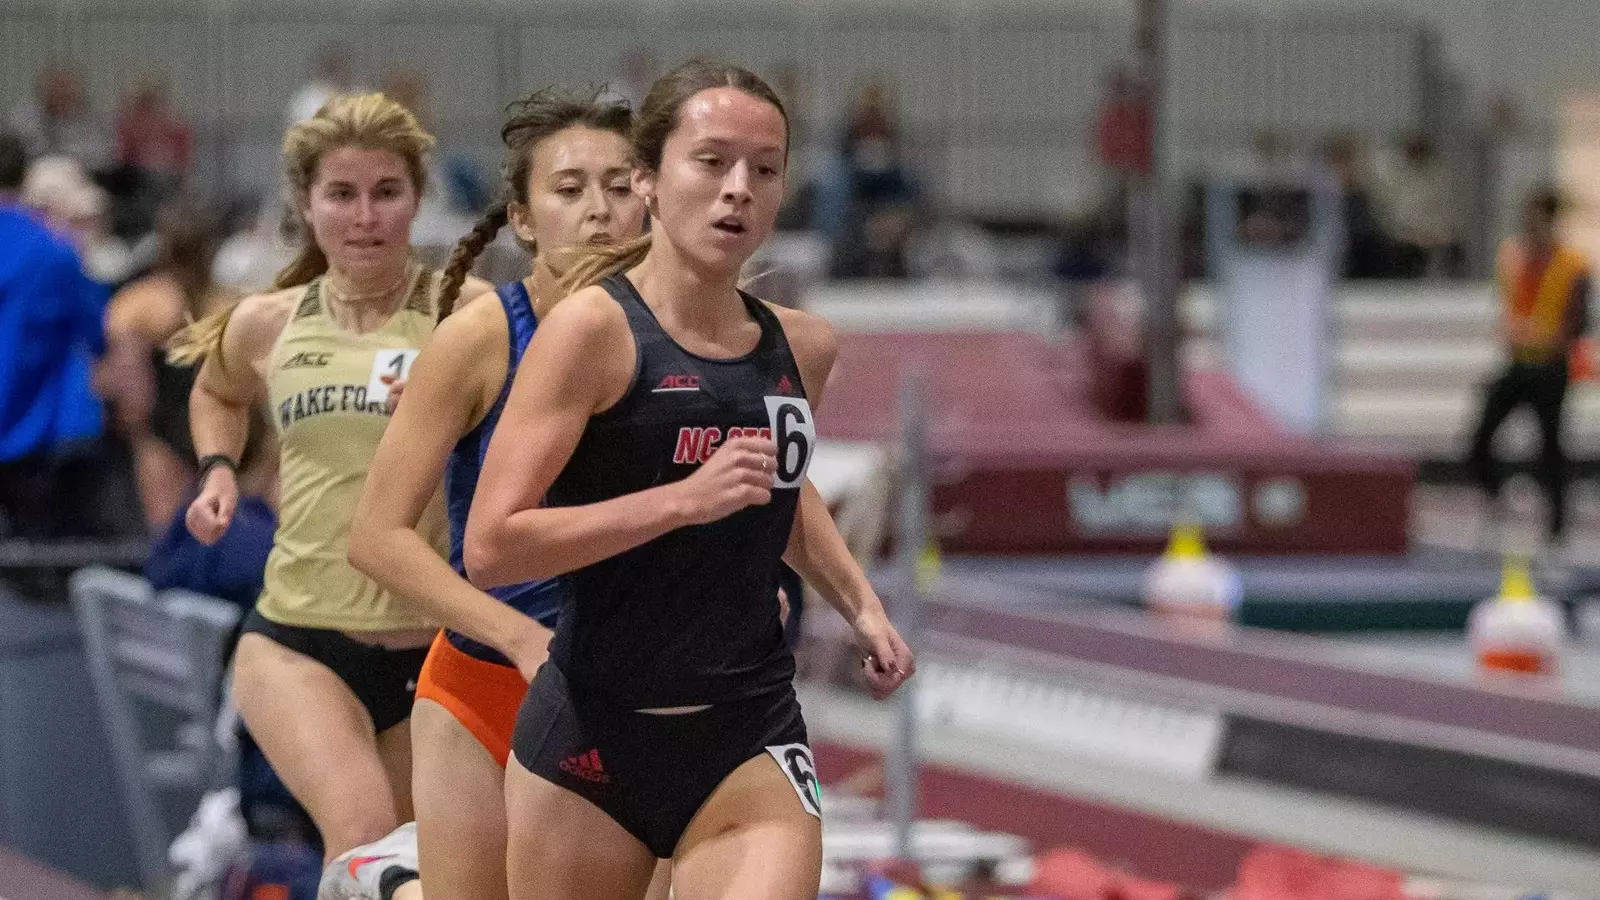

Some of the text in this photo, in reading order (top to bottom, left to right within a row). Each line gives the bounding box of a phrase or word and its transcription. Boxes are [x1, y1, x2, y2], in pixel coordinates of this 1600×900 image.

[281, 351, 334, 370] ACC
[658, 375, 701, 388] ACC
[673, 427, 722, 464] NC
[776, 403, 808, 483] 6
[784, 748, 821, 815] 6
